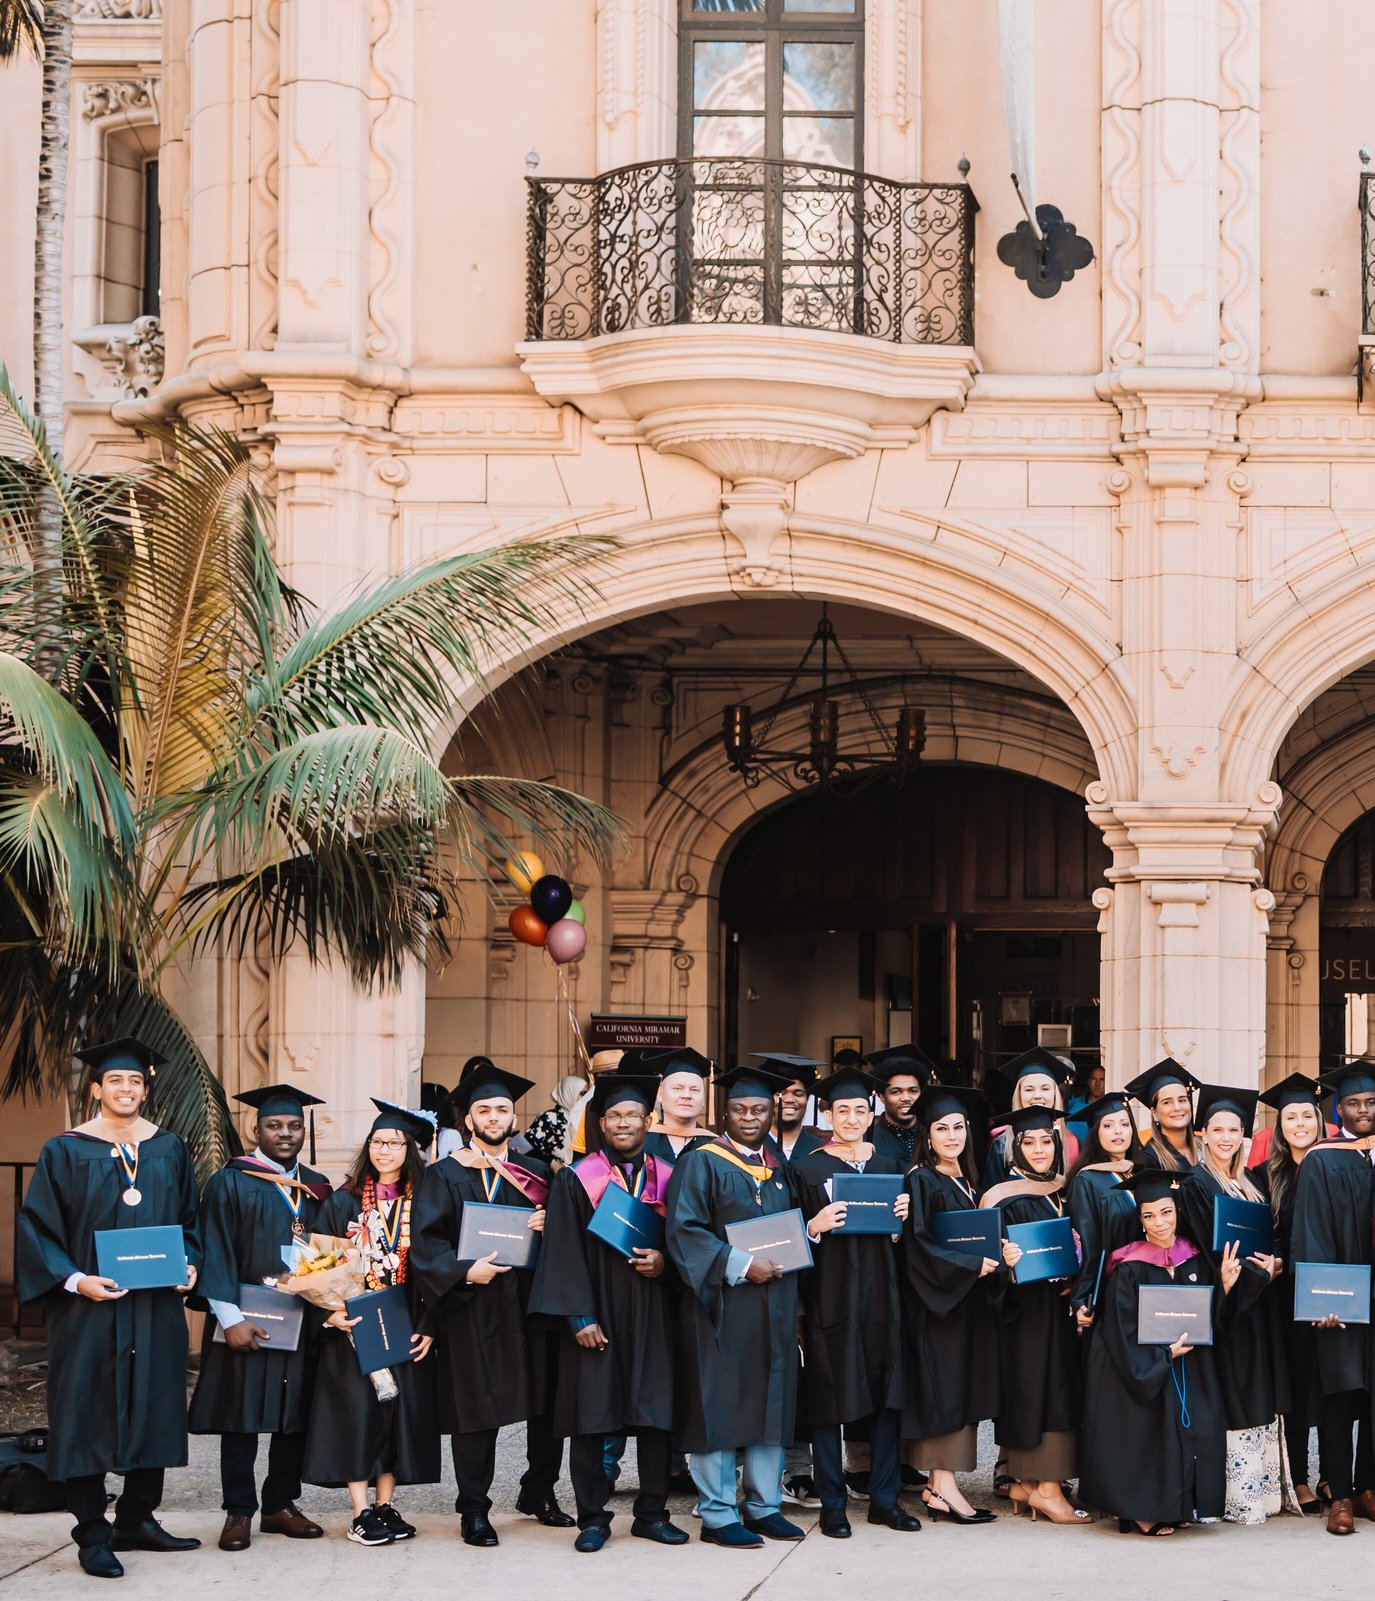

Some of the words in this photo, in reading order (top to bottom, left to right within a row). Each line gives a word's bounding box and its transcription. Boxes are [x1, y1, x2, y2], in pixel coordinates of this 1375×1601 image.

[596, 1024, 642, 1033] CALIFORNIA
[645, 1025, 680, 1034] MIRAMAR
[616, 1035, 659, 1044] UNIVERSITY
